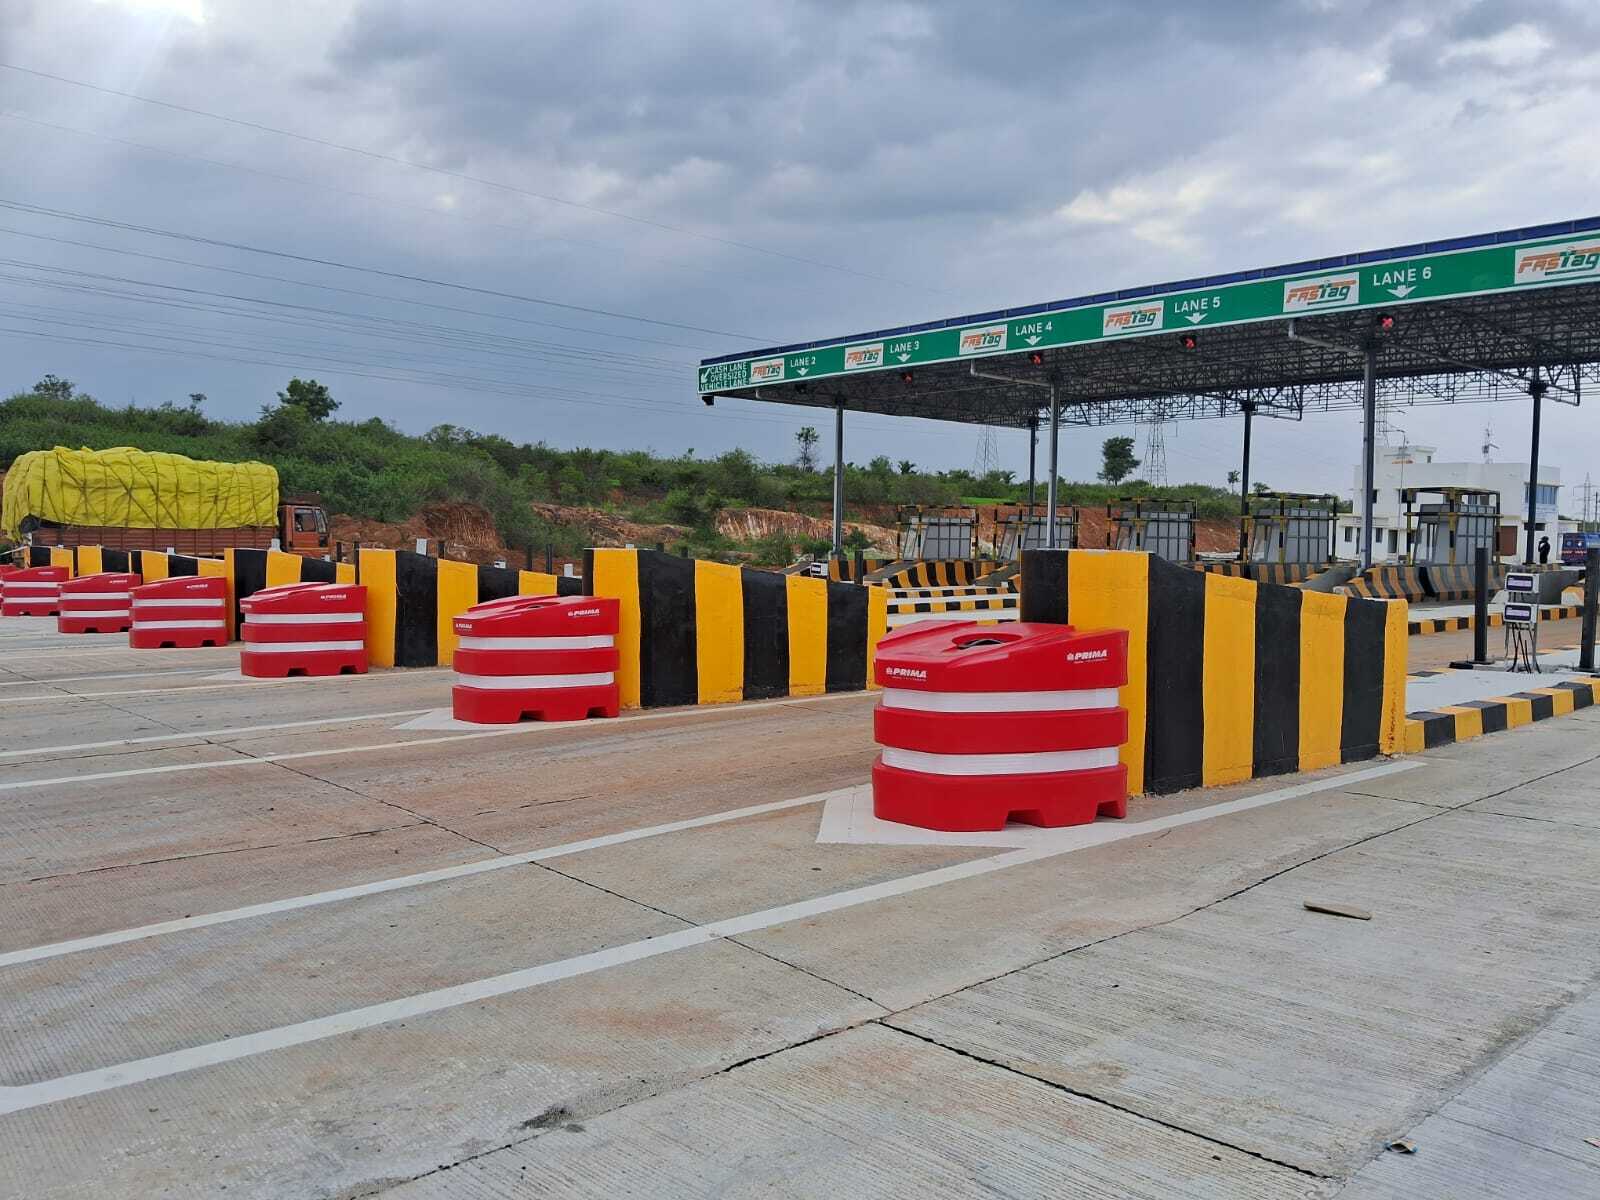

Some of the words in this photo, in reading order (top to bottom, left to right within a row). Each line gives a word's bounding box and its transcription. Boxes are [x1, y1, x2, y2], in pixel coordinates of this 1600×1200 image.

[1373, 268, 1417, 286] LANE
[1422, 266, 1432, 280] 6
[1174, 298, 1209, 313] LANE
[1212, 296, 1221, 308] 5
[1015, 324, 1043, 336] LANE
[1045, 322, 1053, 331] 4
[890, 342, 912, 353] LANE
[913, 340, 920, 350] 3
[711, 365, 728, 375] CASH
[729, 362, 748, 372] LANE
[790, 358, 809, 368] LANE
[811, 356, 816, 365] 2
[710, 371, 747, 382] OVERSIZED
[700, 381, 728, 391] VEHICLE
[730, 378, 748, 388] LANE
[1074, 649, 1107, 660] PRIMA
[893, 667, 927, 678] PRIMA
